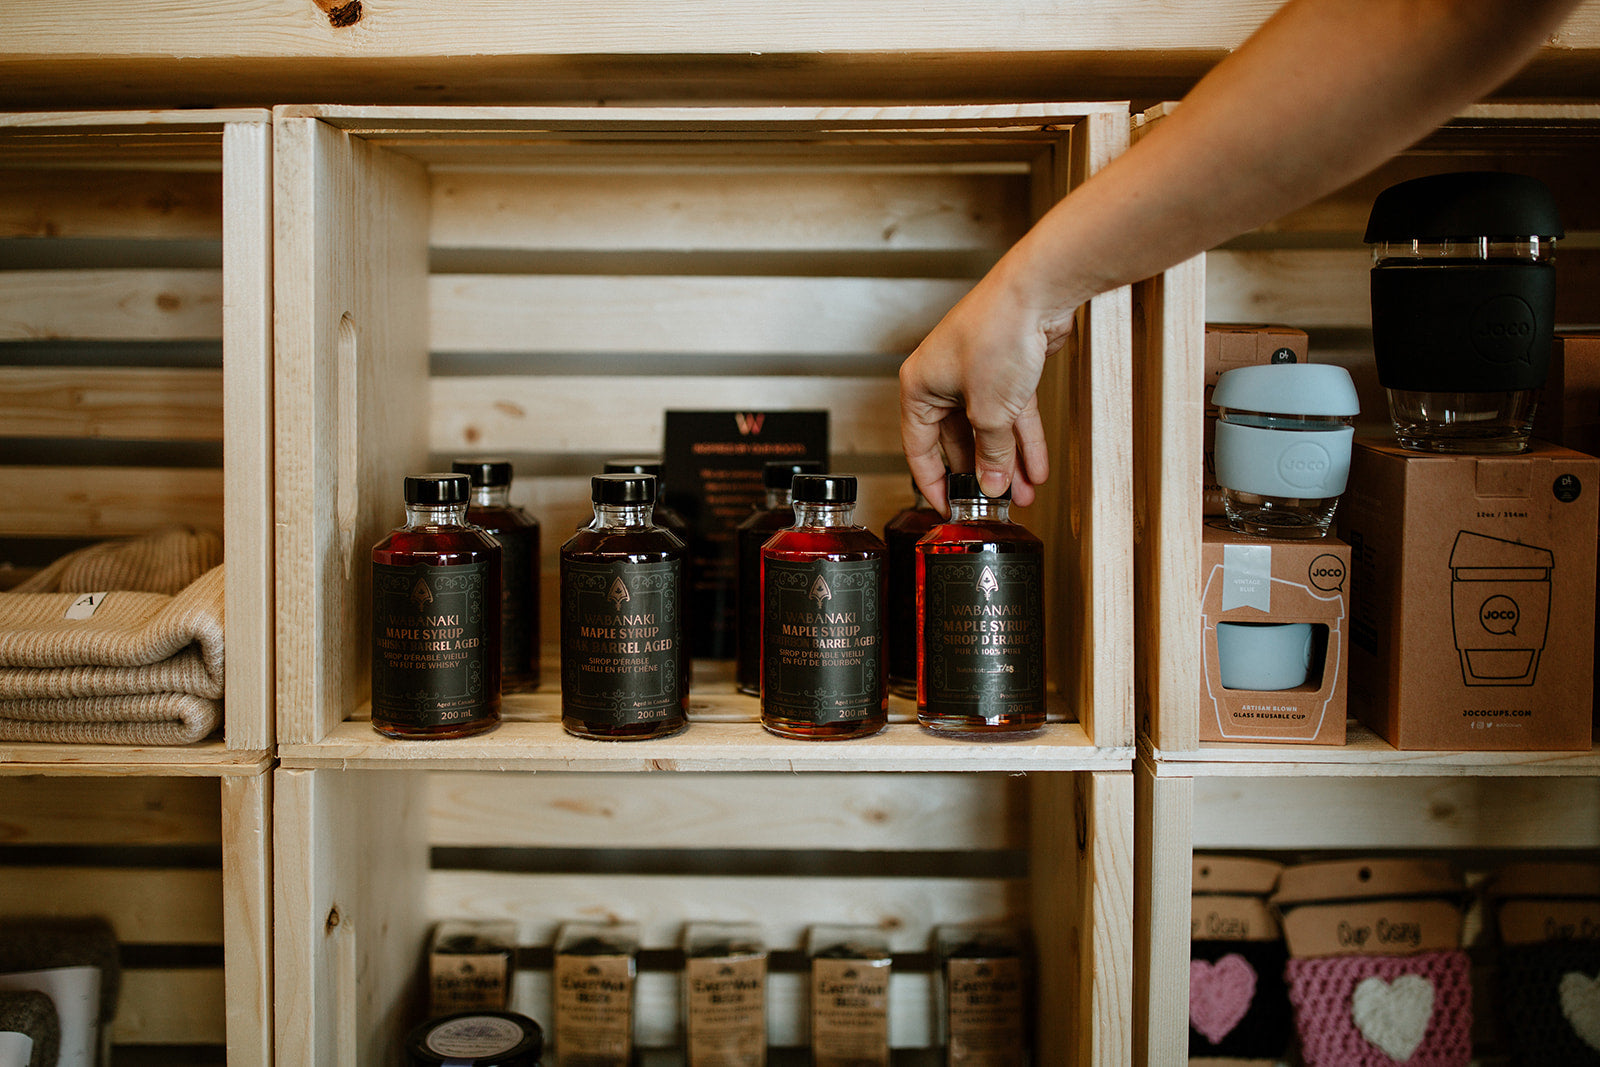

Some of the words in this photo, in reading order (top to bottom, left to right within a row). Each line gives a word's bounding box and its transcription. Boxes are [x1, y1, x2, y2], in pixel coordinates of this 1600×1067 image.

[1285, 460, 1325, 471] JOCO
[1313, 569, 1342, 577] JOCO
[951, 605, 1022, 616] WABANAKI
[1484, 609, 1515, 620] JOCO
[389, 615, 459, 626] WABANAKI
[584, 614, 655, 626] WABANAKI
[785, 612, 856, 624] WABANAKI
[782, 624, 818, 637] MAPLE
[821, 625, 861, 637] SYRUP
[943, 620, 987, 632] MAPLE
[990, 620, 1030, 633] SYRUP
[386, 628, 419, 639] MAPLE
[423, 628, 464, 640] SYRUP
[581, 627, 616, 639] MAPLE
[619, 626, 659, 639] SYRUP
[410, 641, 451, 651] BARREL
[455, 638, 480, 649] AGED
[813, 638, 852, 649] BARREL
[854, 635, 876, 647] AGED
[943, 635, 978, 645] SIROP
[591, 641, 640, 654] BARREL
[644, 639, 672, 653] AGED
[779, 649, 799, 658] SIROP
[840, 650, 865, 658] VIEILLI
[416, 661, 426, 670] DE
[428, 660, 460, 669] WHISKY
[588, 657, 611, 665] SIROP
[782, 657, 791, 665] EN
[822, 658, 861, 667] BOURBON
[581, 664, 603, 673] VIEILLI
[839, 710, 856, 718] 200
[857, 708, 868, 716] mL
[1008, 704, 1023, 712] 200
[441, 711, 459, 720] 200
[461, 709, 472, 718] mL
[637, 711, 654, 720] 200
[656, 709, 668, 717] mL
[1376, 918, 1422, 947] Cozy
